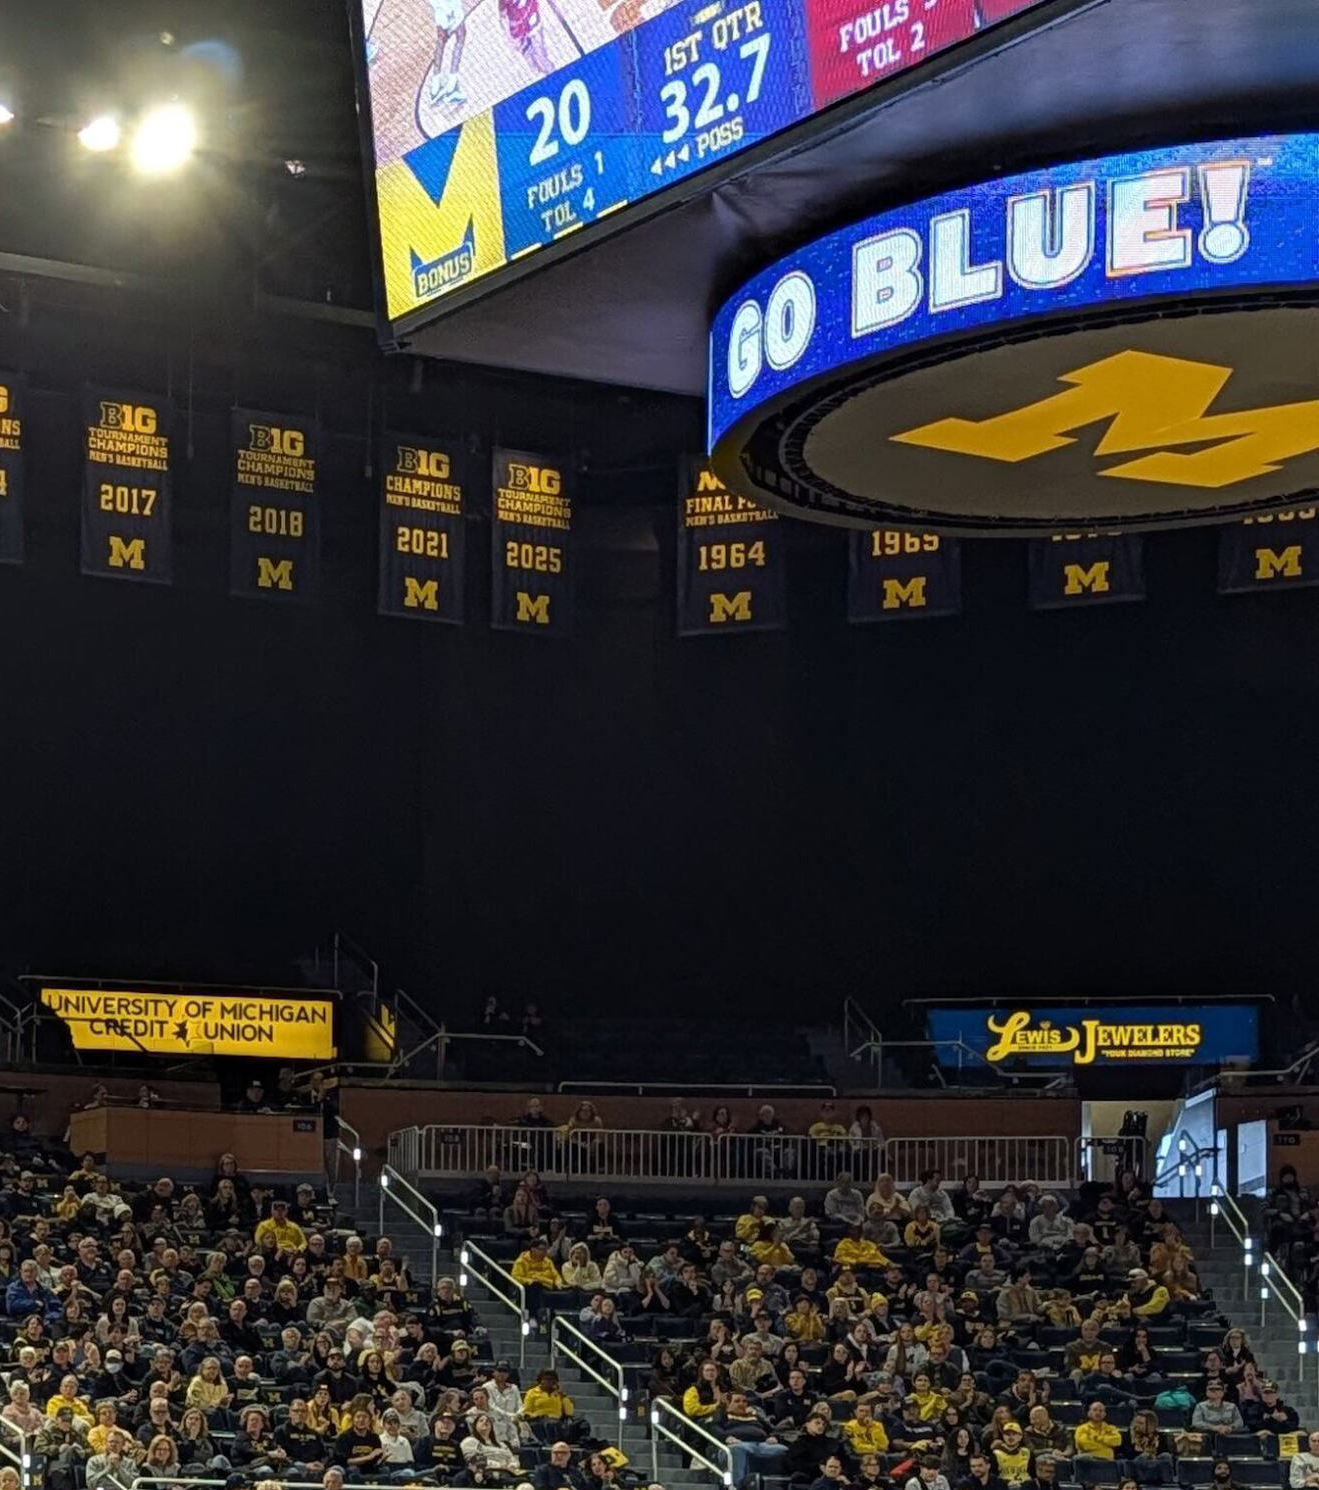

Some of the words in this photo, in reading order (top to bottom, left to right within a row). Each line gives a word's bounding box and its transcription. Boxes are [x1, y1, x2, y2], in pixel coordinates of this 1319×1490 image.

[664, 31, 704, 74] 1ST
[712, 1, 763, 54] QTR
[839, 0, 909, 52] FOULS
[857, 38, 901, 76] TOL
[911, 21, 925, 51] 2
[661, 33, 771, 143] 32.7
[526, 79, 591, 166] 20
[698, 117, 744, 157] POSS
[528, 164, 583, 208] FOULS
[595, 151, 604, 174] 1
[541, 201, 576, 231] TOL
[583, 189, 595, 211] 4
[417, 252, 471, 295] BONUS
[727, 270, 816, 399] GO
[851, 160, 1251, 338] BLUE!
[88, 426, 167, 447] TOURNAMENT
[88, 438, 168, 459] CHAMPIONS
[237, 450, 315, 469] TOURNAMENT
[237, 460, 315, 481] CHAMPIONS
[99, 483, 156, 516] 2017
[386, 475, 460, 502] CHAMPIONS
[497, 488, 571, 507] TOURNAMENT
[685, 495, 732, 514] FINAL
[248, 506, 305, 538] 2018
[497, 498, 571, 519] CHAMPIONS
[109, 536, 144, 570] M
[396, 528, 447, 557] 2021
[506, 541, 561, 572] 2025
[699, 541, 765, 571] 1964
[258, 557, 292, 589] M
[1064, 561, 1109, 595] M
[1255, 546, 1302, 579] M
[405, 578, 438, 610] M
[517, 592, 549, 623] M
[710, 591, 752, 622] M
[882, 577, 926, 609] M
[47, 994, 179, 1019] UNIVERSITY
[185, 1000, 212, 1021] OF
[220, 1001, 327, 1025] MICHIGAN
[90, 1018, 169, 1039] CREDIT
[204, 1020, 275, 1043] UNION
